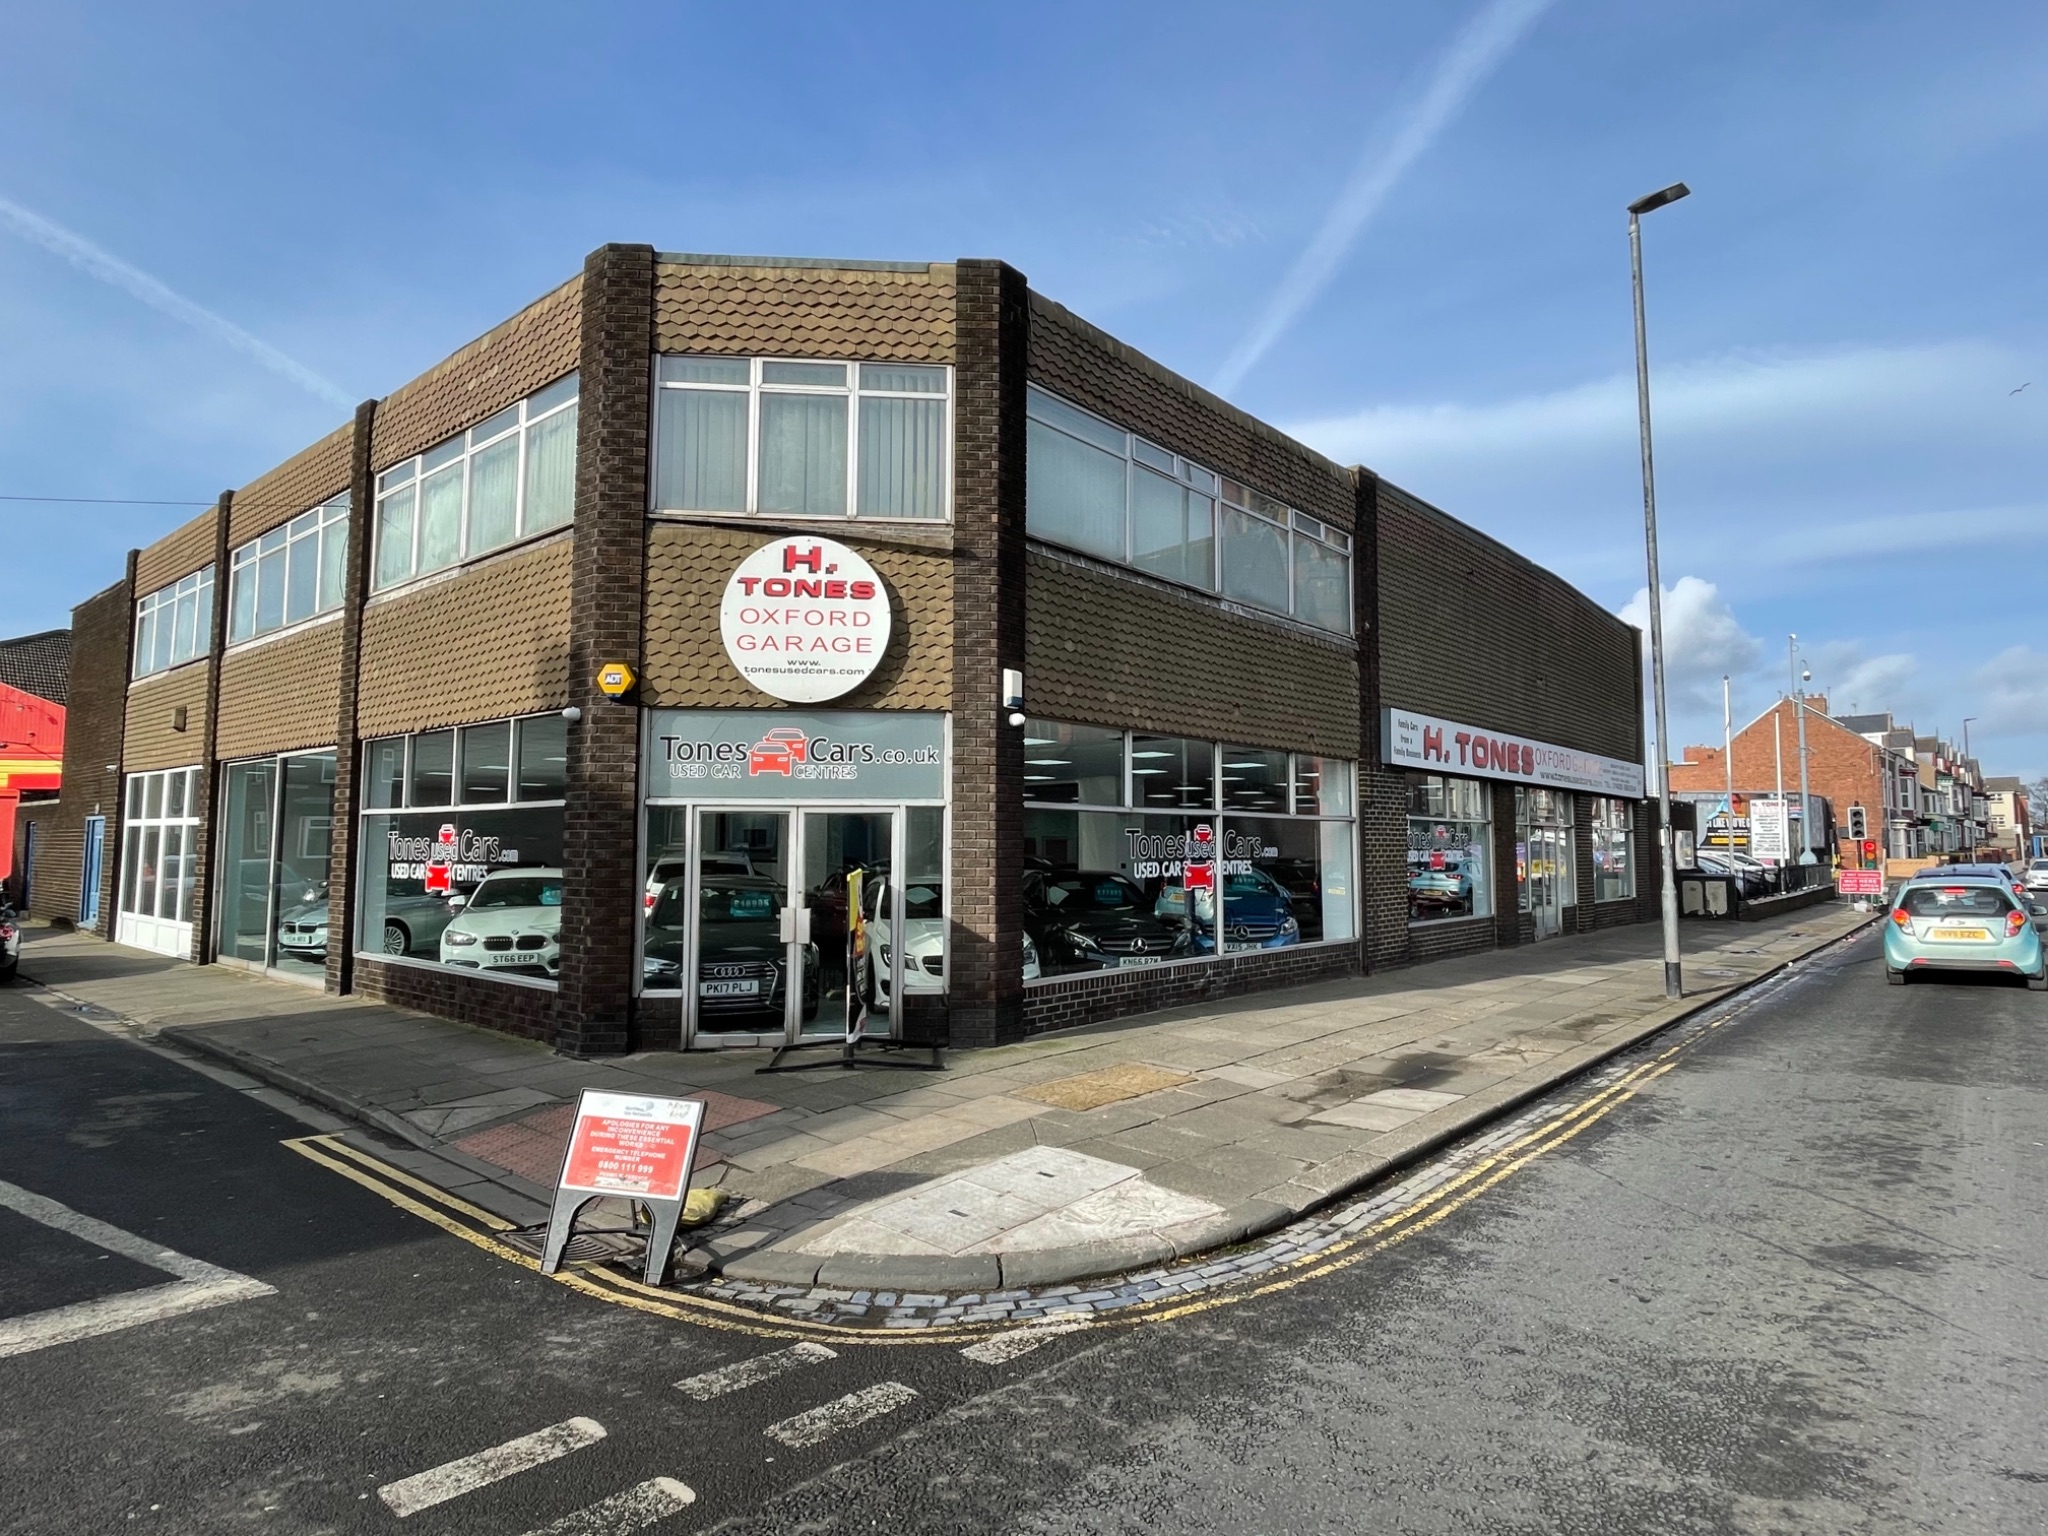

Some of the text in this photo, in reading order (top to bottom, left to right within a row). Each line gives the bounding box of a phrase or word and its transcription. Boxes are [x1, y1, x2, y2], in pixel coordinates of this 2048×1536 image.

[783, 545, 838, 574] H.
[737, 577, 876, 600] TONES
[739, 608, 871, 627] OXFORD
[736, 635, 873, 653] GARAGE
[744, 666, 865, 676] tonesusedcars.com
[605, 674, 622, 684] ADT
[1424, 725, 1450, 763] H.
[1455, 732, 1534, 776] TONES
[1535, 748, 1571, 771] OXFORD
[669, 764, 857, 779] USED CAR CENTRES
[391, 863, 488, 882] USED CAR CENTRES
[1134, 861, 1159, 878] USED
[1161, 861, 1182, 877] CAR
[493, 954, 535, 963] ST66 EEP
[706, 982, 752, 993] PK17 PLJ
[602, 1119, 640, 1129] APOLOGIES
[590, 1130, 675, 1145] DURING THESE ESSENTIAL
[607, 1126, 661, 1137] INCONVENIENCE
[619, 1140, 643, 1148] WORKS
[591, 1146, 666, 1159] EMERGENCY TELEPHONE
[614, 1154, 640, 1162] NUMBER
[598, 1160, 653, 1174] 0800 111 999
